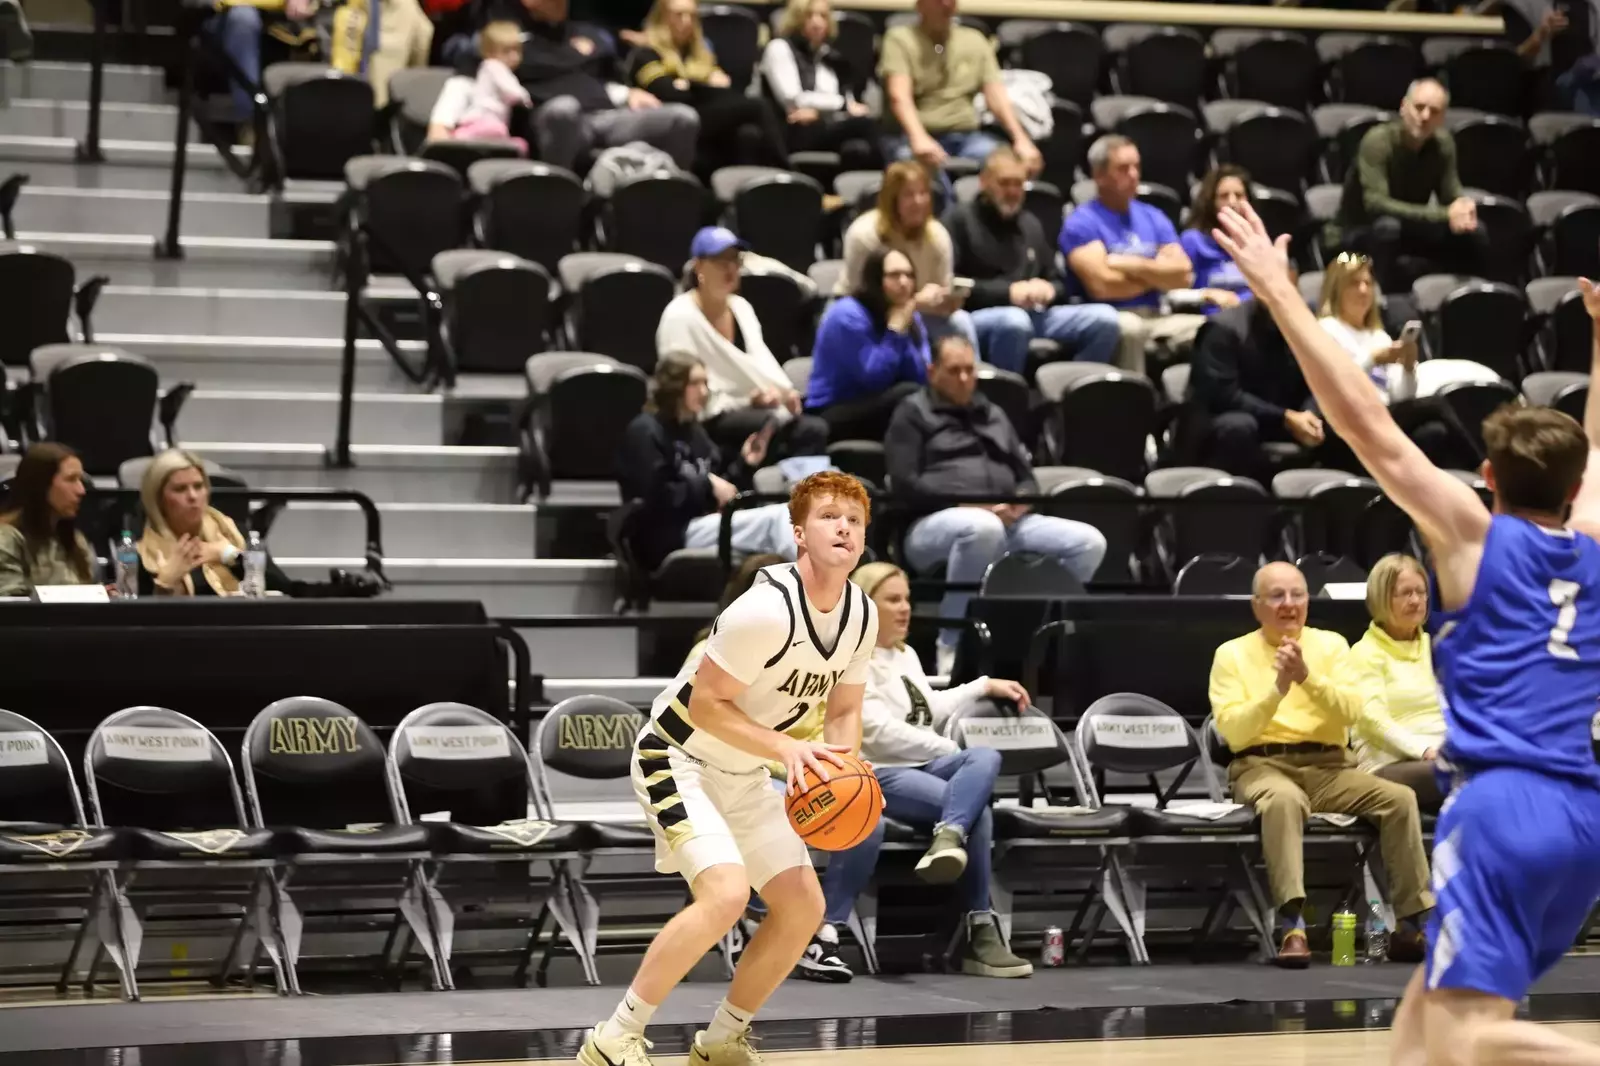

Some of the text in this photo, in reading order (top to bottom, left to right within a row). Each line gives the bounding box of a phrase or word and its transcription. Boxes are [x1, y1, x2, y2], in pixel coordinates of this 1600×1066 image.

[776, 668, 845, 698] ARMY
[269, 716, 356, 754] ARMY
[559, 714, 643, 750] ARMY
[991, 725, 1020, 736] WEST
[1122, 723, 1150, 735] WEST
[138, 735, 170, 748] WEST
[173, 735, 205, 748] POINT
[441, 736, 472, 748] WEST
[793, 789, 836, 825] ELITE
